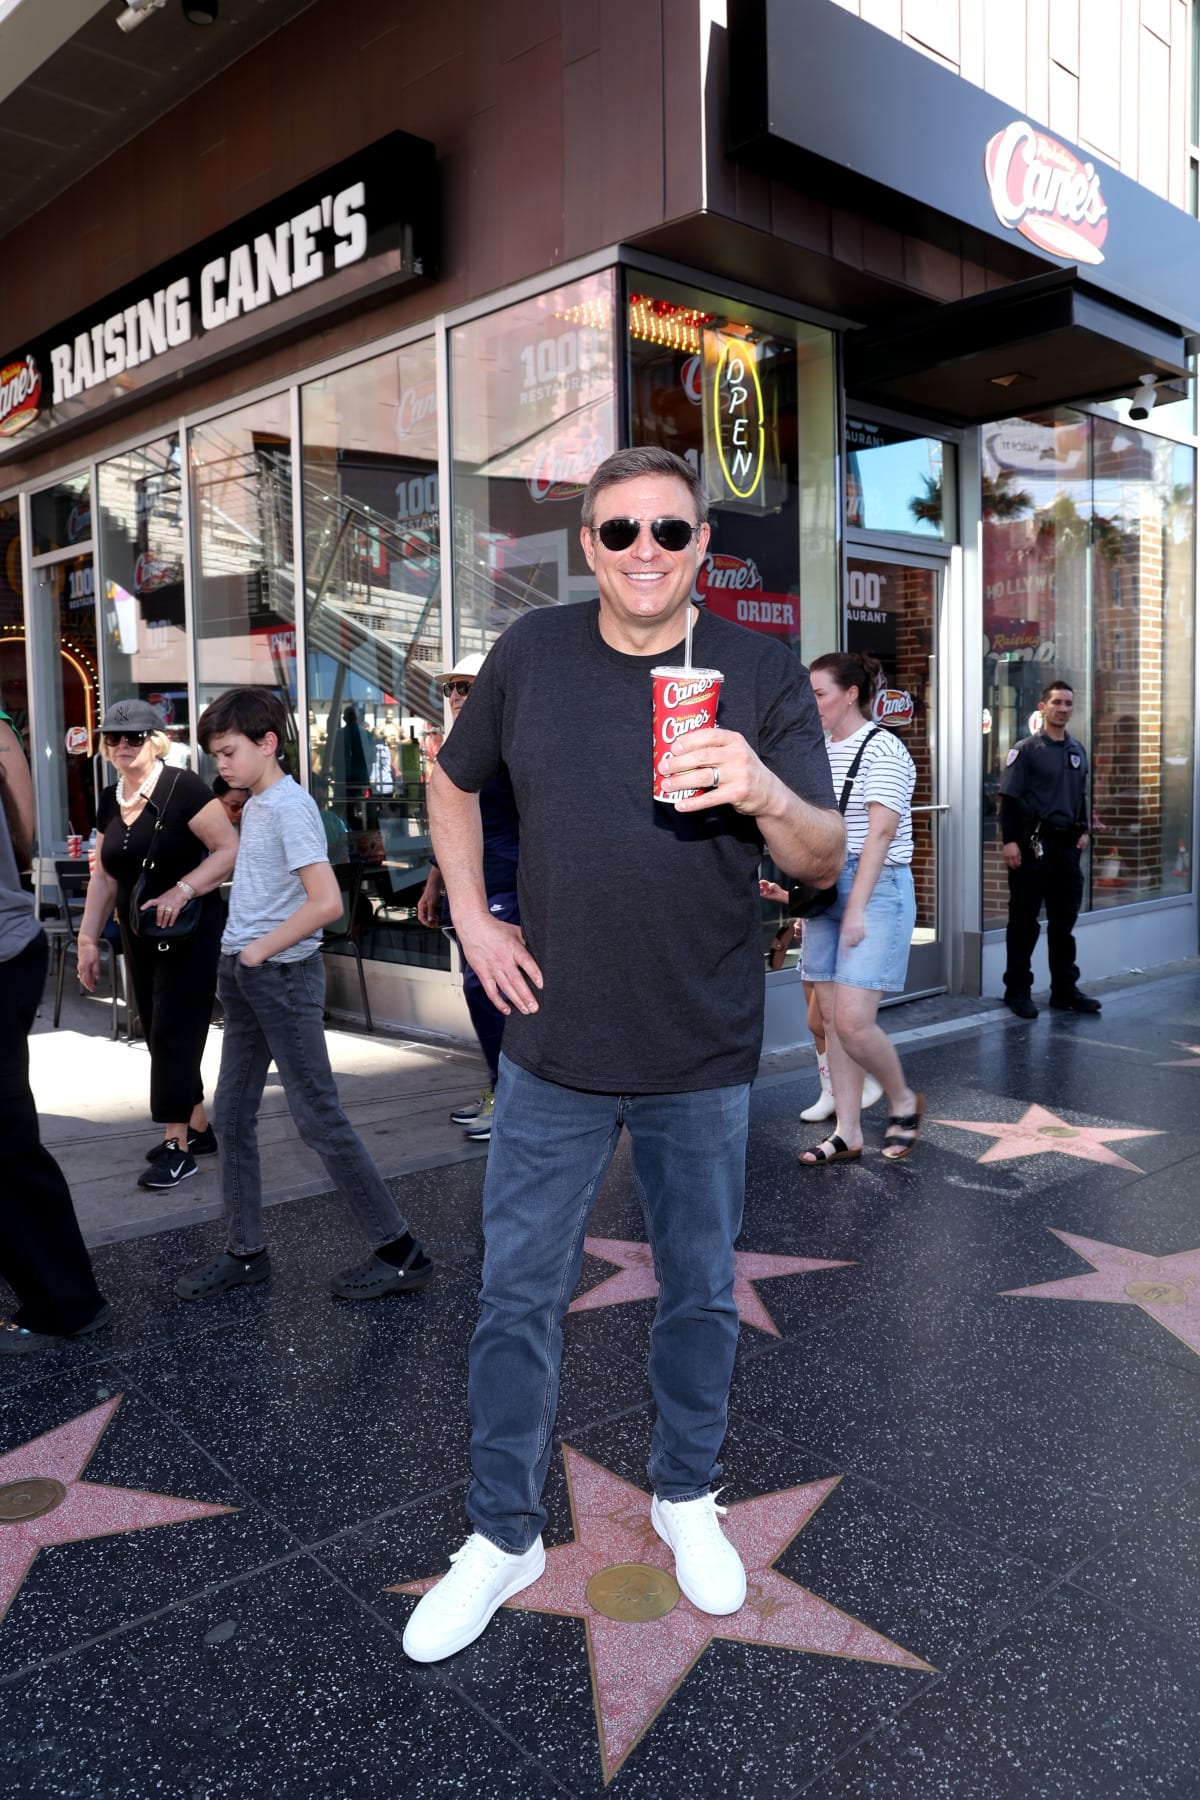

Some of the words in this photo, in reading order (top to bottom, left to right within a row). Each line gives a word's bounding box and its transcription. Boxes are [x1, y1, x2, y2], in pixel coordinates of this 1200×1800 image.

[991, 120, 1108, 225] Cane's
[50, 276, 193, 405] RAISING
[200, 181, 368, 331] CANE'S
[0, 354, 38, 420] ane's
[726, 358, 753, 477] OPEN
[691, 552, 761, 602] Cane's
[737, 600, 794, 625] ORDER
[847, 609, 887, 623] AURANT
[661, 709, 710, 744] Cane's
[872, 689, 914, 722] Cane's
